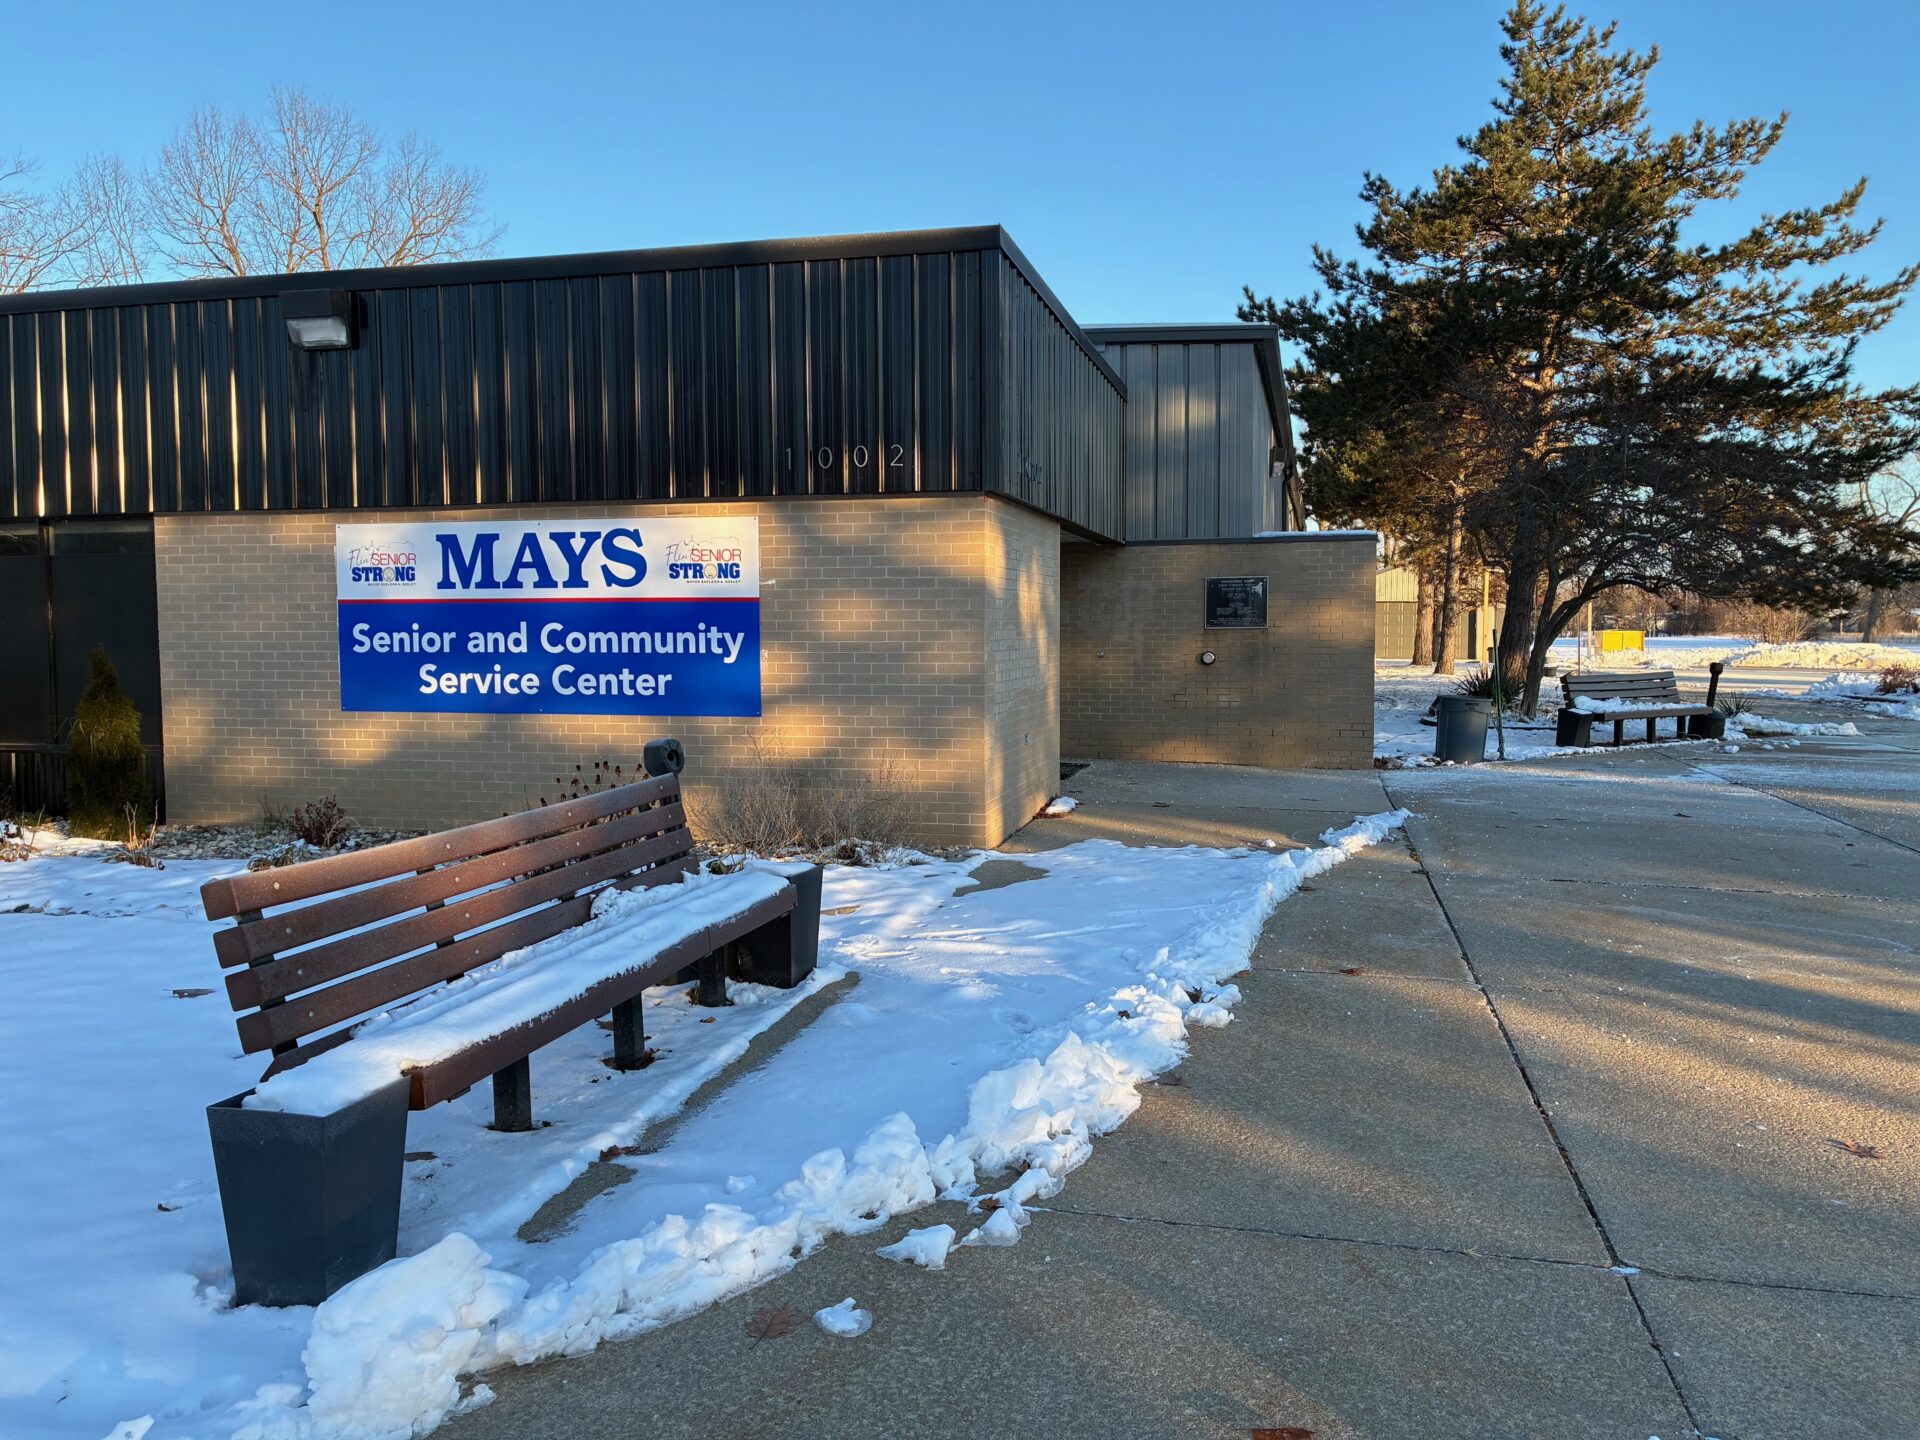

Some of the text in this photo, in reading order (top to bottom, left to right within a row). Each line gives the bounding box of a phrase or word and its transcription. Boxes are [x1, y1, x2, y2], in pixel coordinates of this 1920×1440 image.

[785, 444, 904, 470] 1002
[372, 553, 417, 566] SENIOR
[435, 528, 648, 590] MAYS
[691, 548, 742, 562] SENIOR
[352, 621, 745, 664] Senior and Community
[419, 664, 672, 696] Service Center
